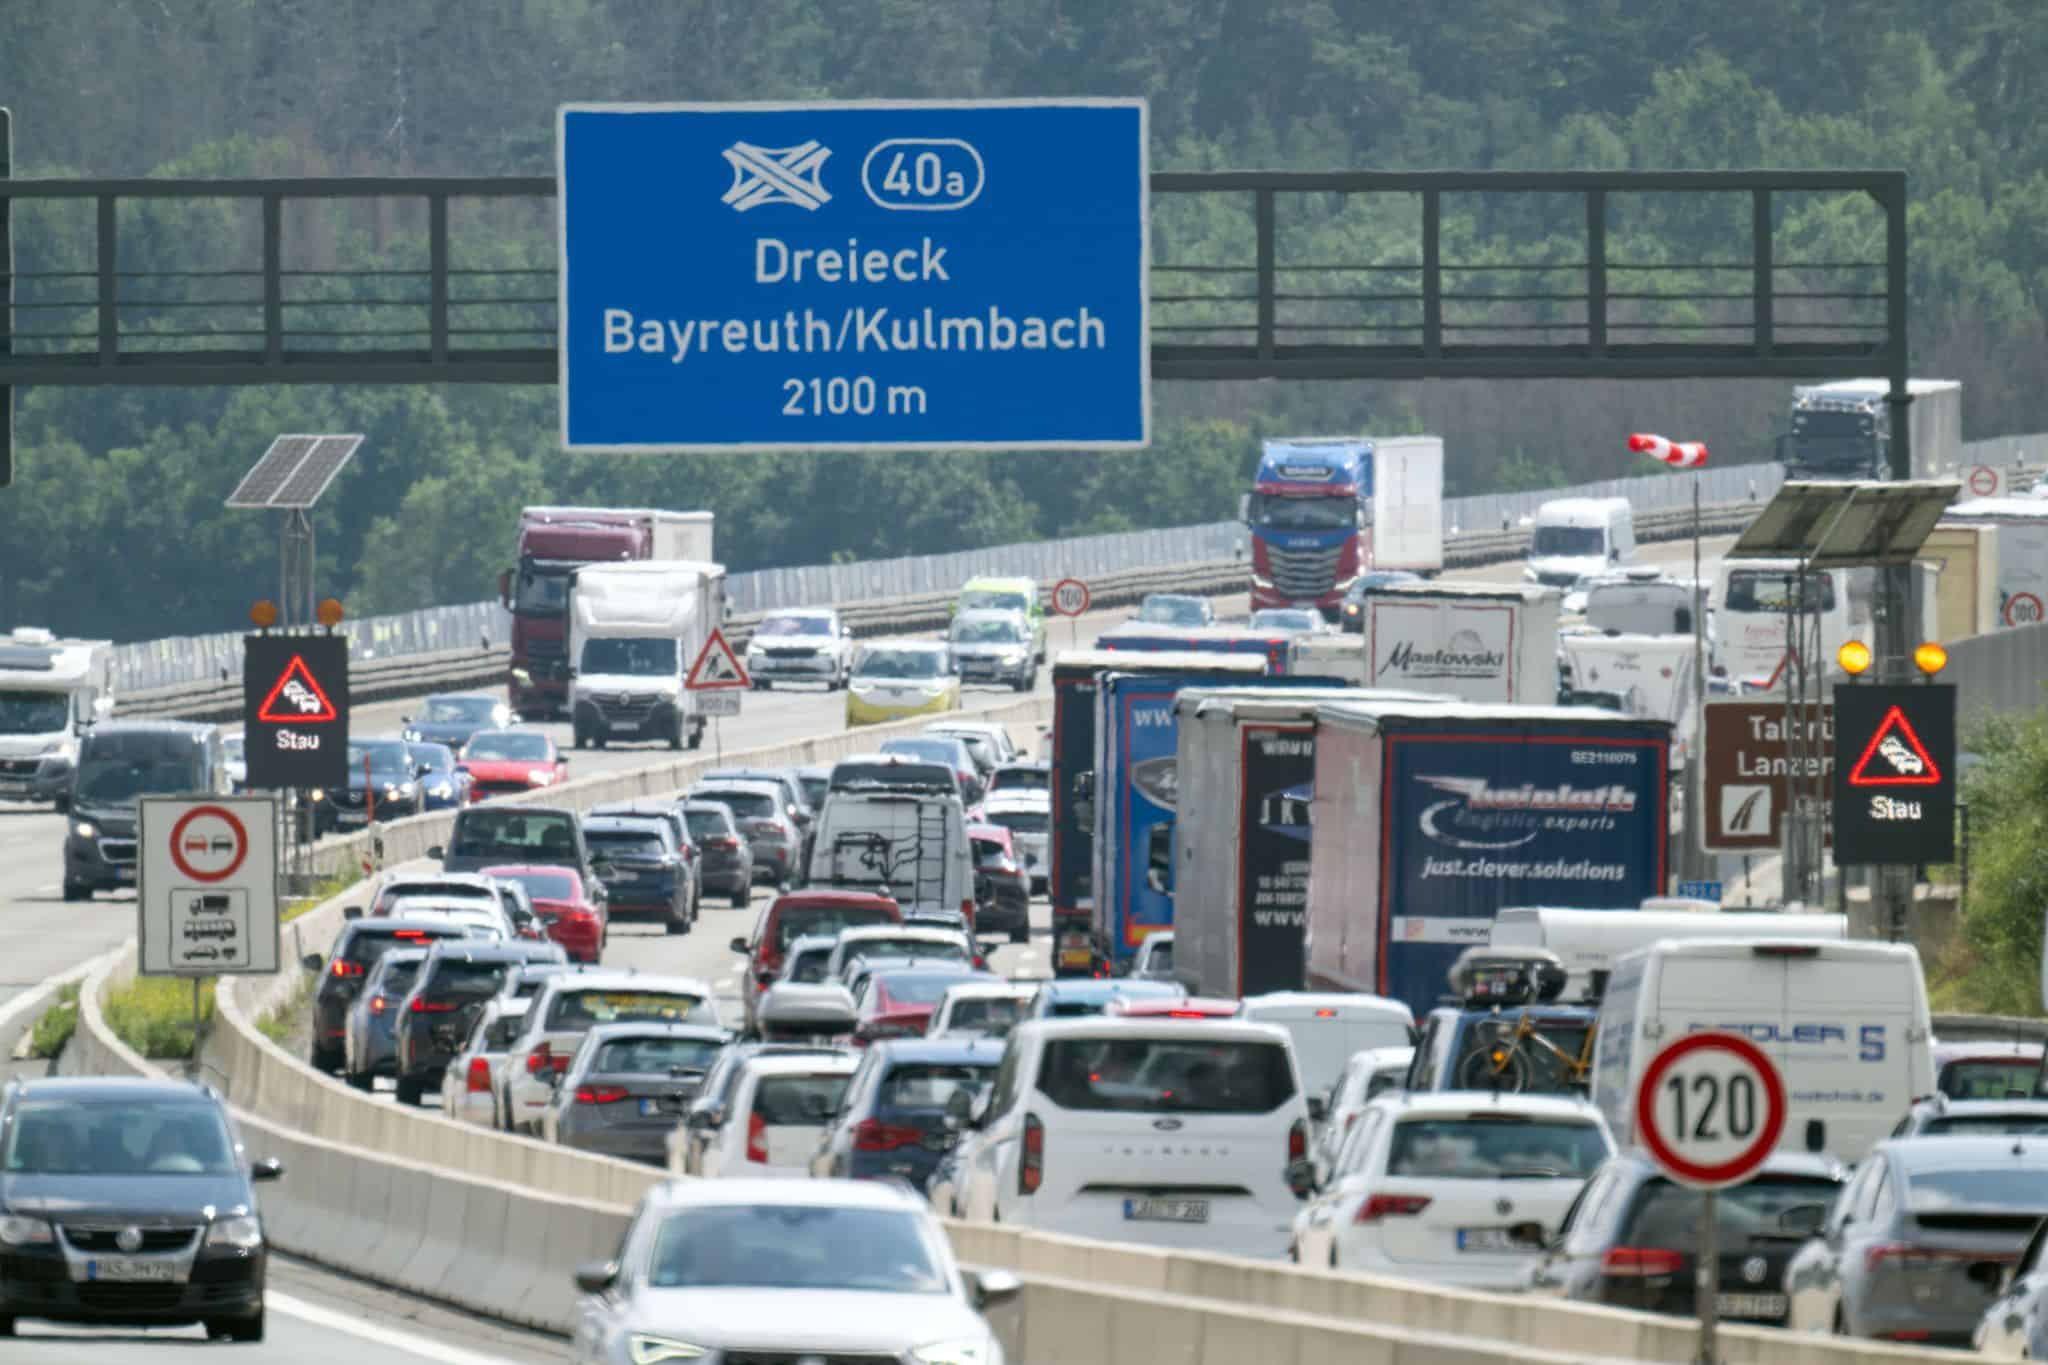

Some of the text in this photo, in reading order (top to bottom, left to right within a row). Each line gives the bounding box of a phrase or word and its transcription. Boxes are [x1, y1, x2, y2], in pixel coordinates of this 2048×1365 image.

[882, 151, 965, 197] 40a
[754, 237, 950, 283] Dreieck
[603, 306, 1106, 363] Bayreuth/Kulmbach
[782, 377, 927, 416] 2100 m
[276, 730, 320, 750] Stau
[1870, 797, 1922, 820] Stau
[1668, 1074, 1756, 1141] 120
